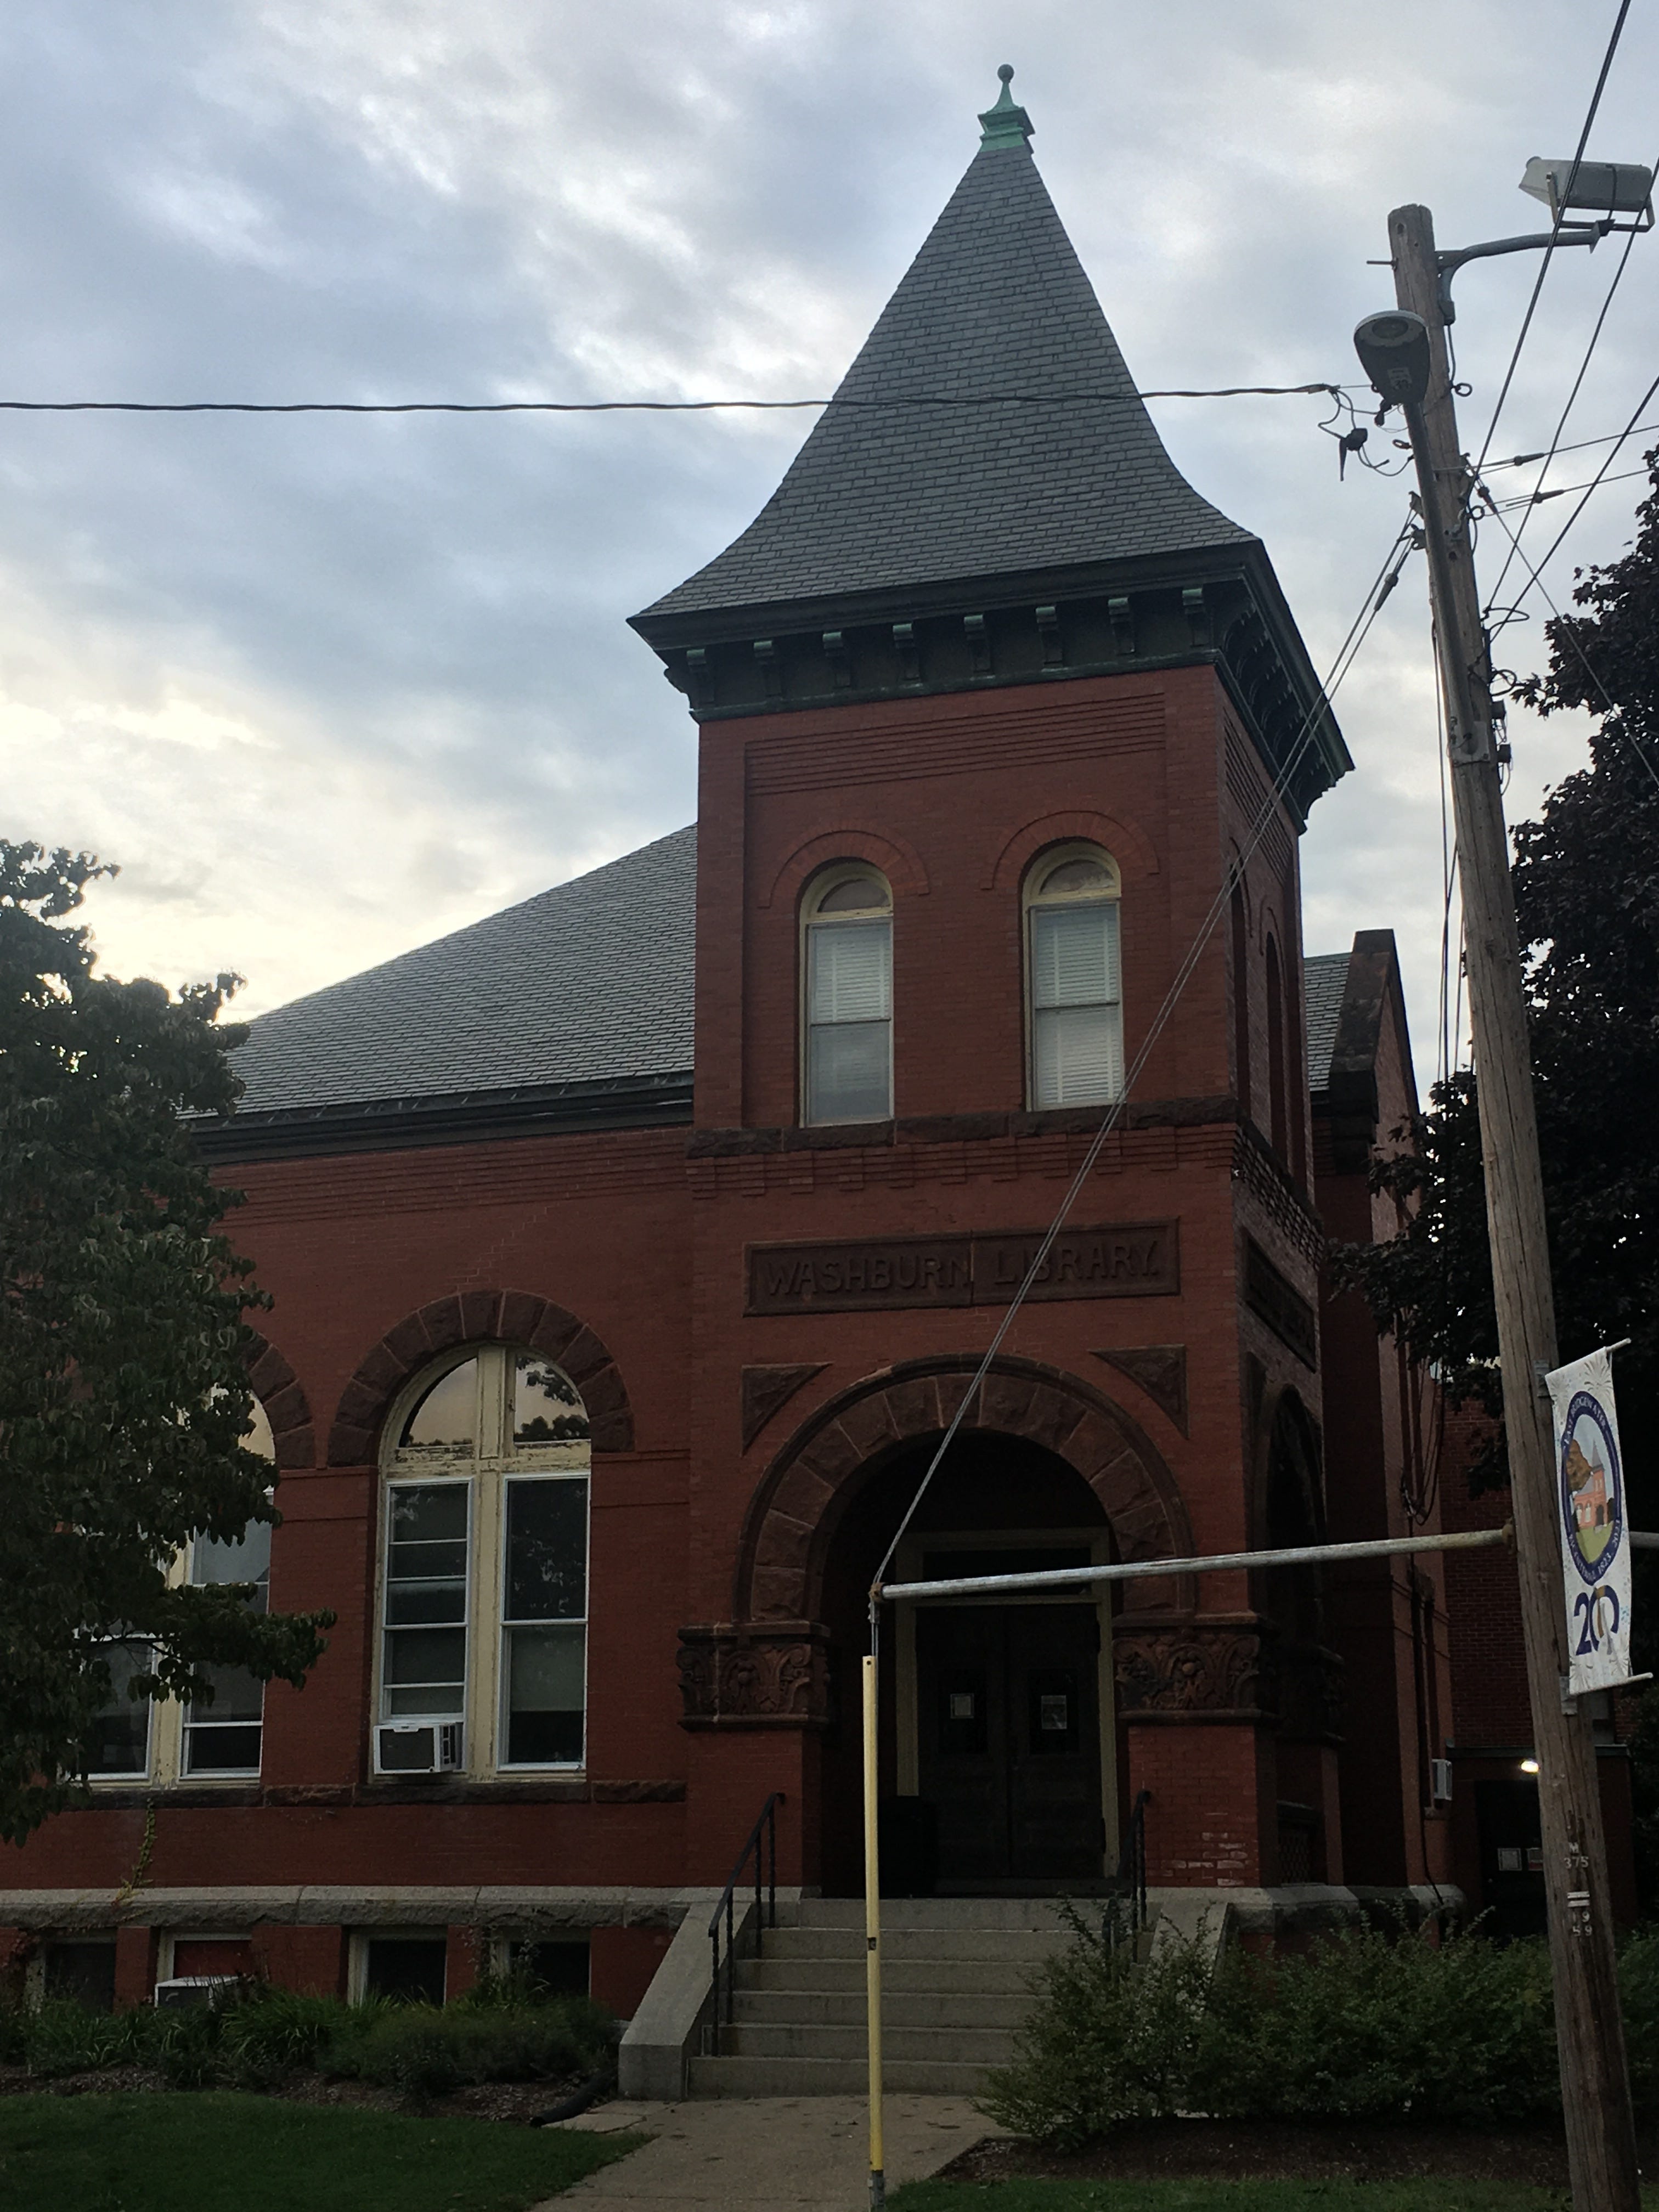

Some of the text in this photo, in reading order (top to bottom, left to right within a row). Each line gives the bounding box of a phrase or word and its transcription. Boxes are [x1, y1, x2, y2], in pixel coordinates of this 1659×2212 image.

[768, 1254, 970, 1296] WASHBURN
[1564, 1855, 1589, 1869] 375
[1572, 1925, 1593, 1937] 59
